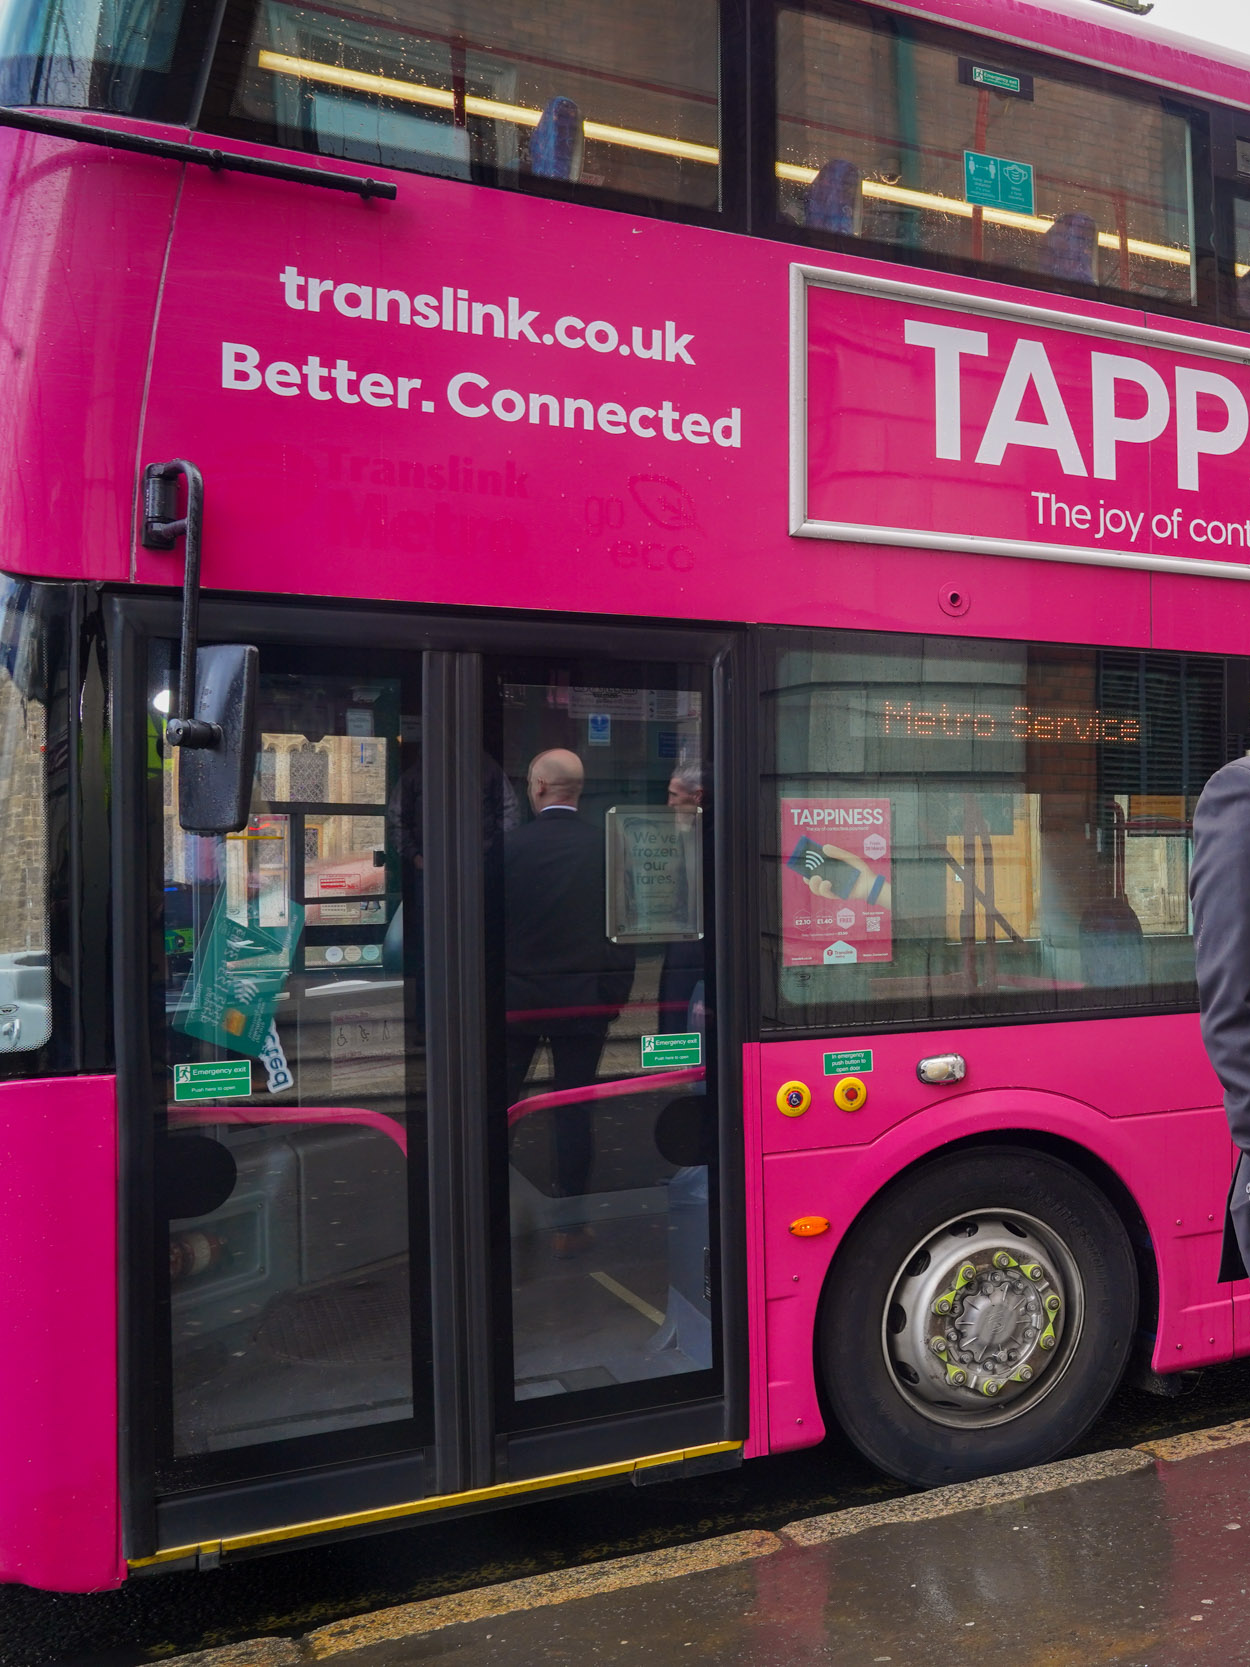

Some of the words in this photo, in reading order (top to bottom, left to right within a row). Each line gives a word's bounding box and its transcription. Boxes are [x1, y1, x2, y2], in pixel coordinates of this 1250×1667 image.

[280, 265, 696, 366] translink.co.uk
[221, 342, 435, 413] Better.
[447, 372, 742, 448] Connected
[1031, 492, 1092, 531] The
[1095, 500, 1145, 543] joy
[1151, 508, 1183, 540] of
[885, 700, 995, 736] Metro
[1011, 706, 1140, 740] Service
[790, 808, 884, 825] TAPPINESS
[631, 846, 678, 858] frozen
[643, 861, 669, 872] our
[636, 874, 676, 885] fares.
[656, 1039, 687, 1047] Emergency
[837, 1051, 865, 1060] emergency
[831, 1059, 845, 1067] push
[192, 1067, 233, 1077] Emergency
